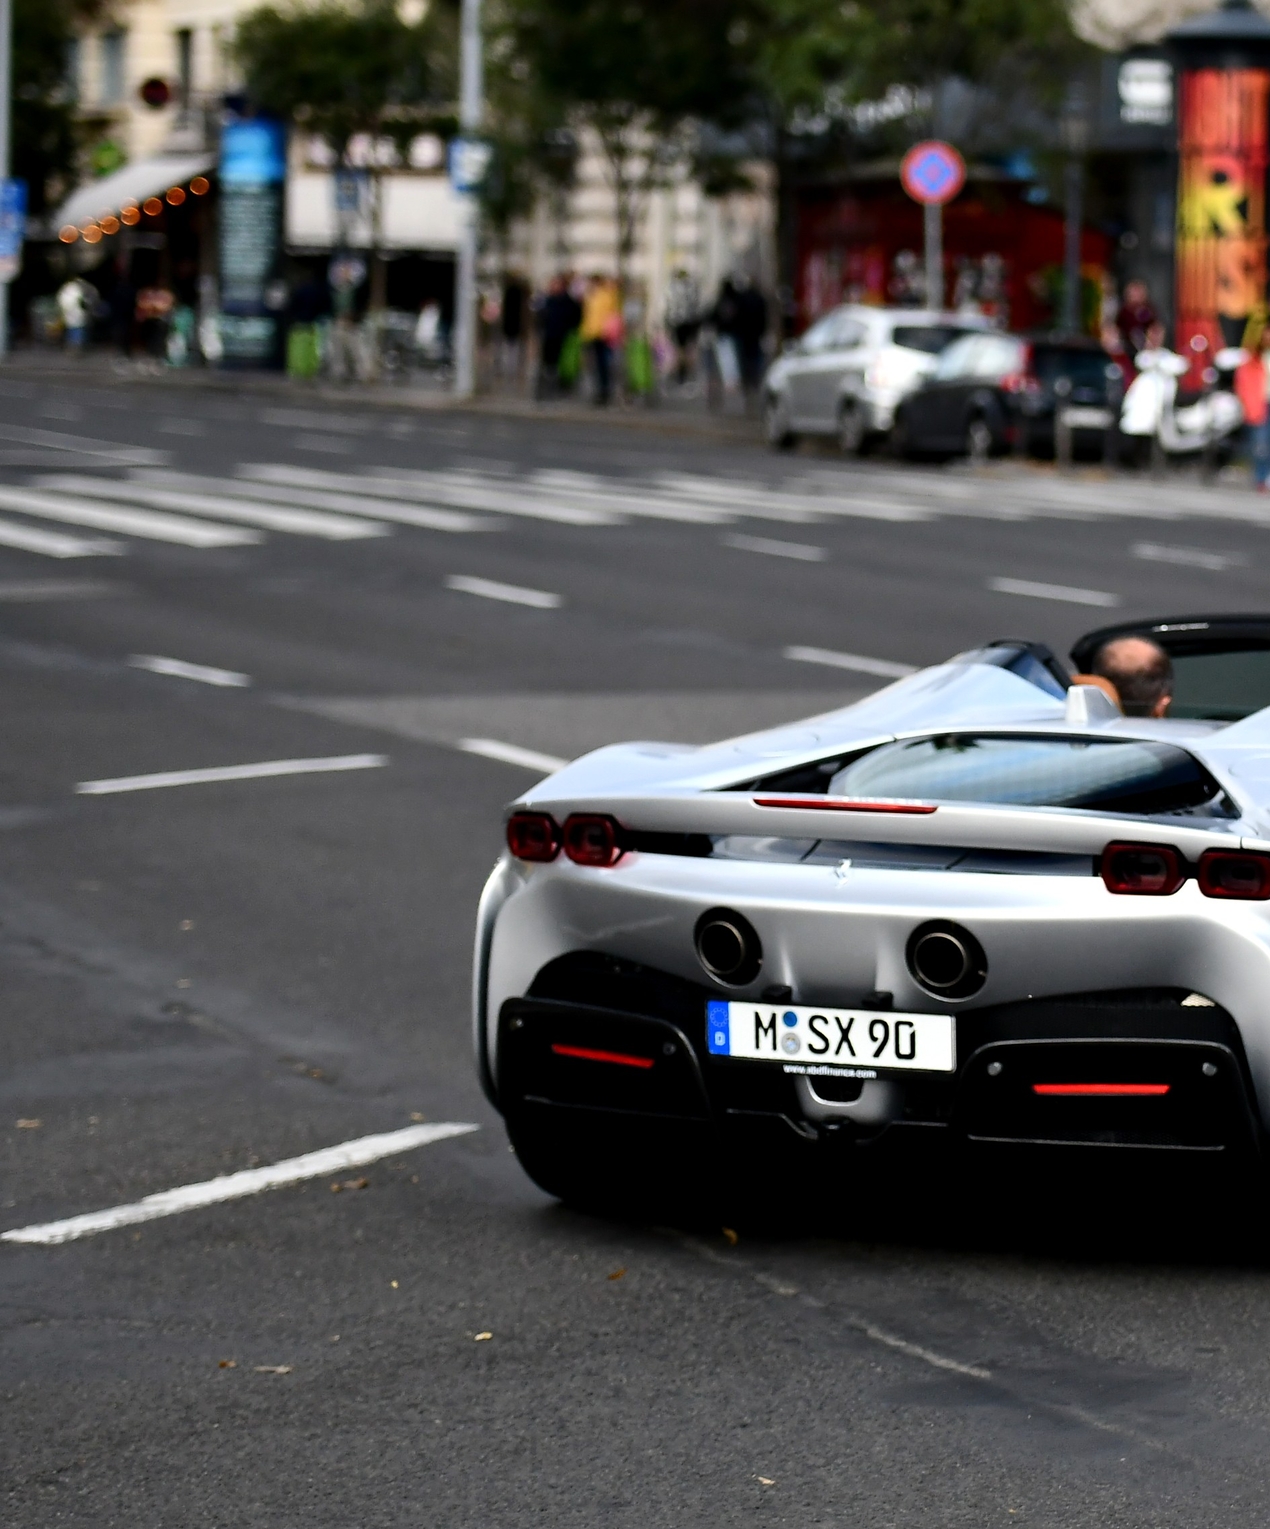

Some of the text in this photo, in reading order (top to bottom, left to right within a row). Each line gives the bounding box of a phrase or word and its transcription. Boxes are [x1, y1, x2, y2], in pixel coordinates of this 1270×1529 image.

[754, 1011, 916, 1060] M SX 90
